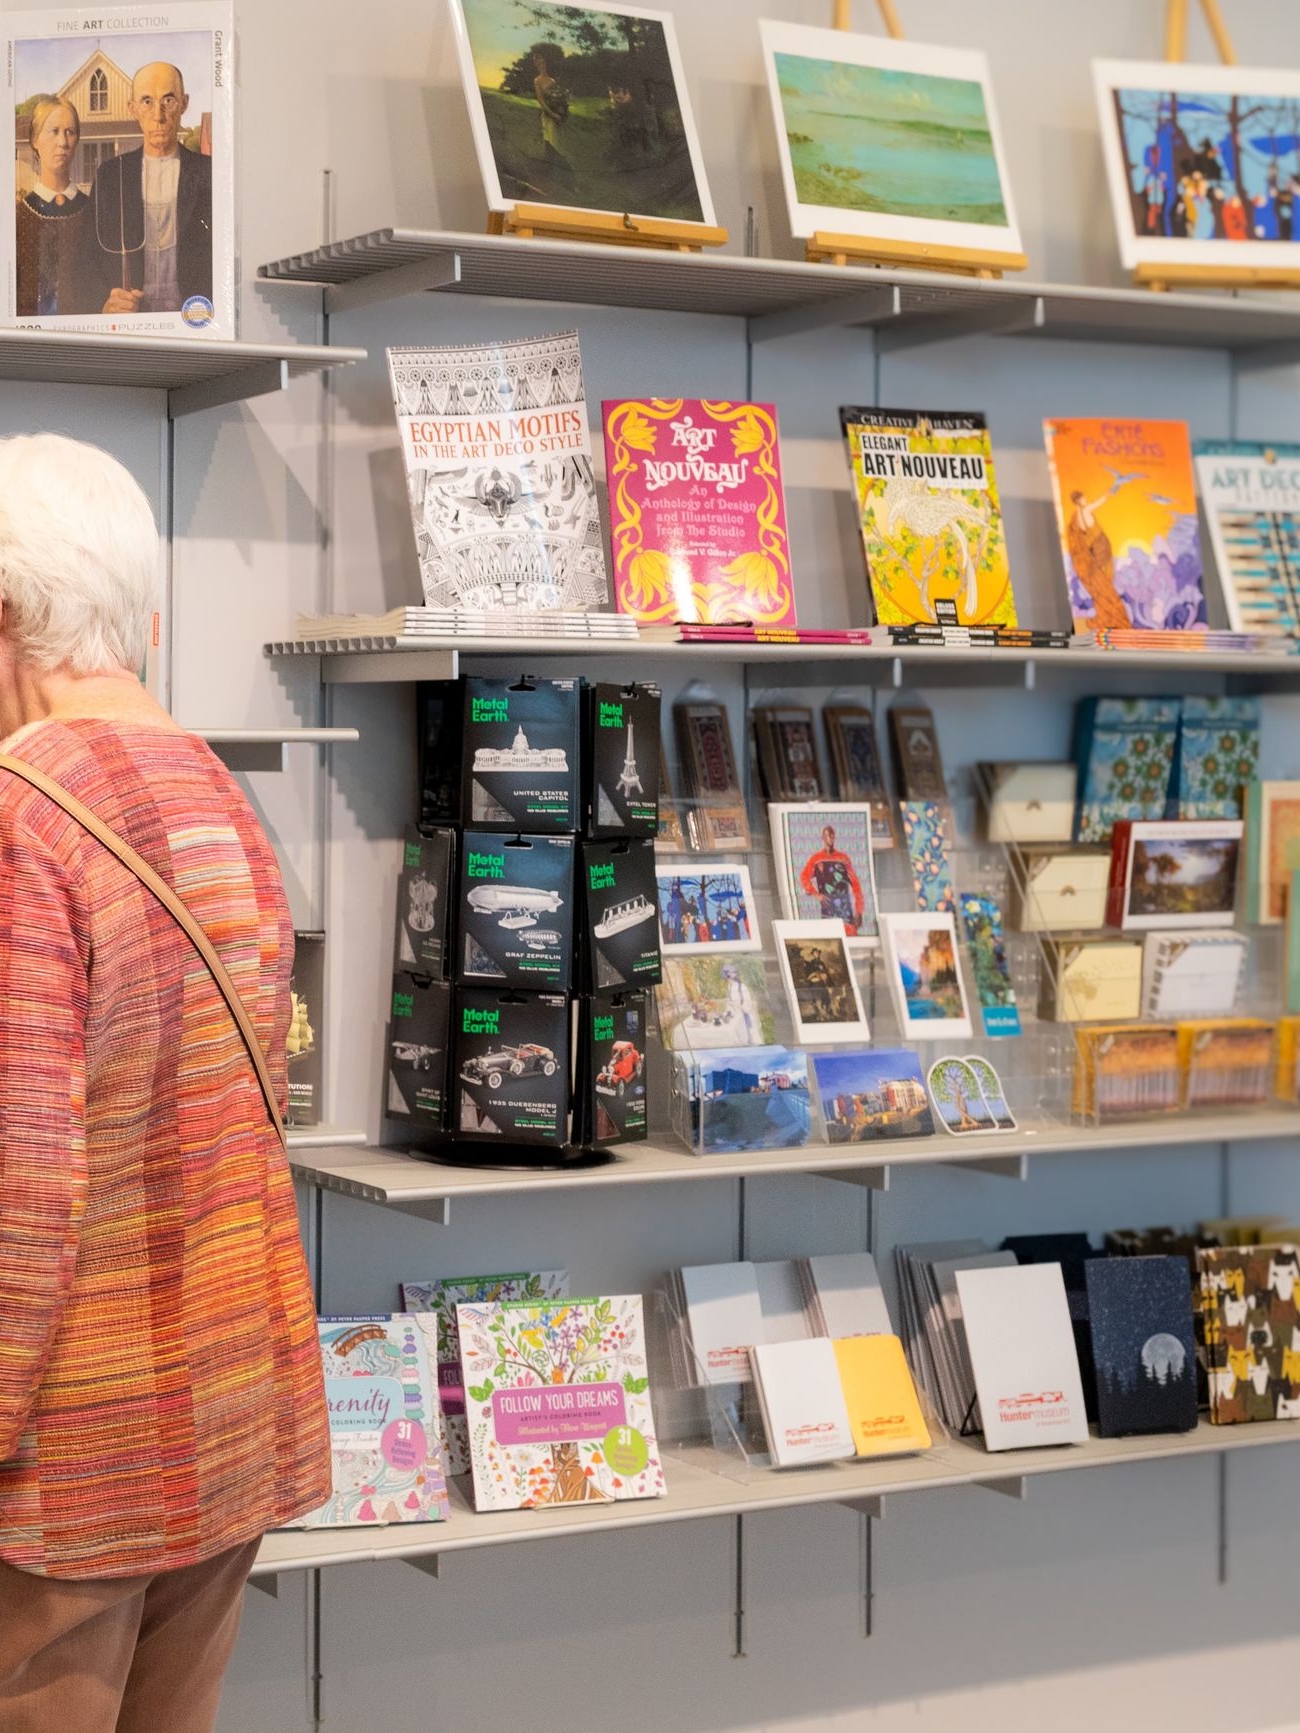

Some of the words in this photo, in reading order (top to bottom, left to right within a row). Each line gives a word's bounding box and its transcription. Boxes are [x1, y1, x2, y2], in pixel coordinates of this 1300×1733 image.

[57, 20, 80, 32] FINE
[82, 19, 105, 31] ART
[106, 16, 170, 30] COLLECTION
[214, 30, 223, 57] Grant
[214, 59, 223, 87] Wood
[118, 321, 176, 331] PUZZLES
[409, 420, 501, 443] EGYPTIAN
[507, 410, 582, 439] MOTIFS
[860, 414, 915, 427] CREATIVE
[933, 418, 975, 429] HAVEN
[669, 415, 717, 454] ART
[414, 445, 429, 458] IN
[431, 444, 458, 458] THE
[462, 444, 489, 458] ART
[494, 441, 534, 457] DECO
[540, 433, 583, 452] STYLE
[862, 435, 907, 452] ELEGANT
[642, 455, 749, 494] NOUVEAU
[864, 453, 896, 476] ART
[900, 455, 984, 480] NOUVEAU
[1212, 468, 1251, 489] ART
[688, 484, 708, 497] An
[641, 497, 701, 511] Anthology
[703, 498, 715, 509] of
[716, 498, 757, 513] Design
[656, 511, 678, 522] and
[681, 511, 745, 525] Illustration
[686, 524, 706, 536] The
[708, 524, 746, 537] Studio
[472, 698, 509, 710] Metal
[600, 702, 623, 716] Metal
[468, 852, 505, 865] Metal
[589, 862, 614, 877] Metal
[463, 1008, 500, 1022] Metal
[593, 1015, 614, 1029] Metal
[500, 1396, 543, 1414] FOLLOW
[544, 1393, 574, 1410] YOUR
[577, 1389, 619, 1408] DREAMS
[331, 1418, 366, 1426] COLORING
[549, 1413, 582, 1421] COLORING
[397, 1421, 412, 1439] 31
[617, 1428, 632, 1446] 31
